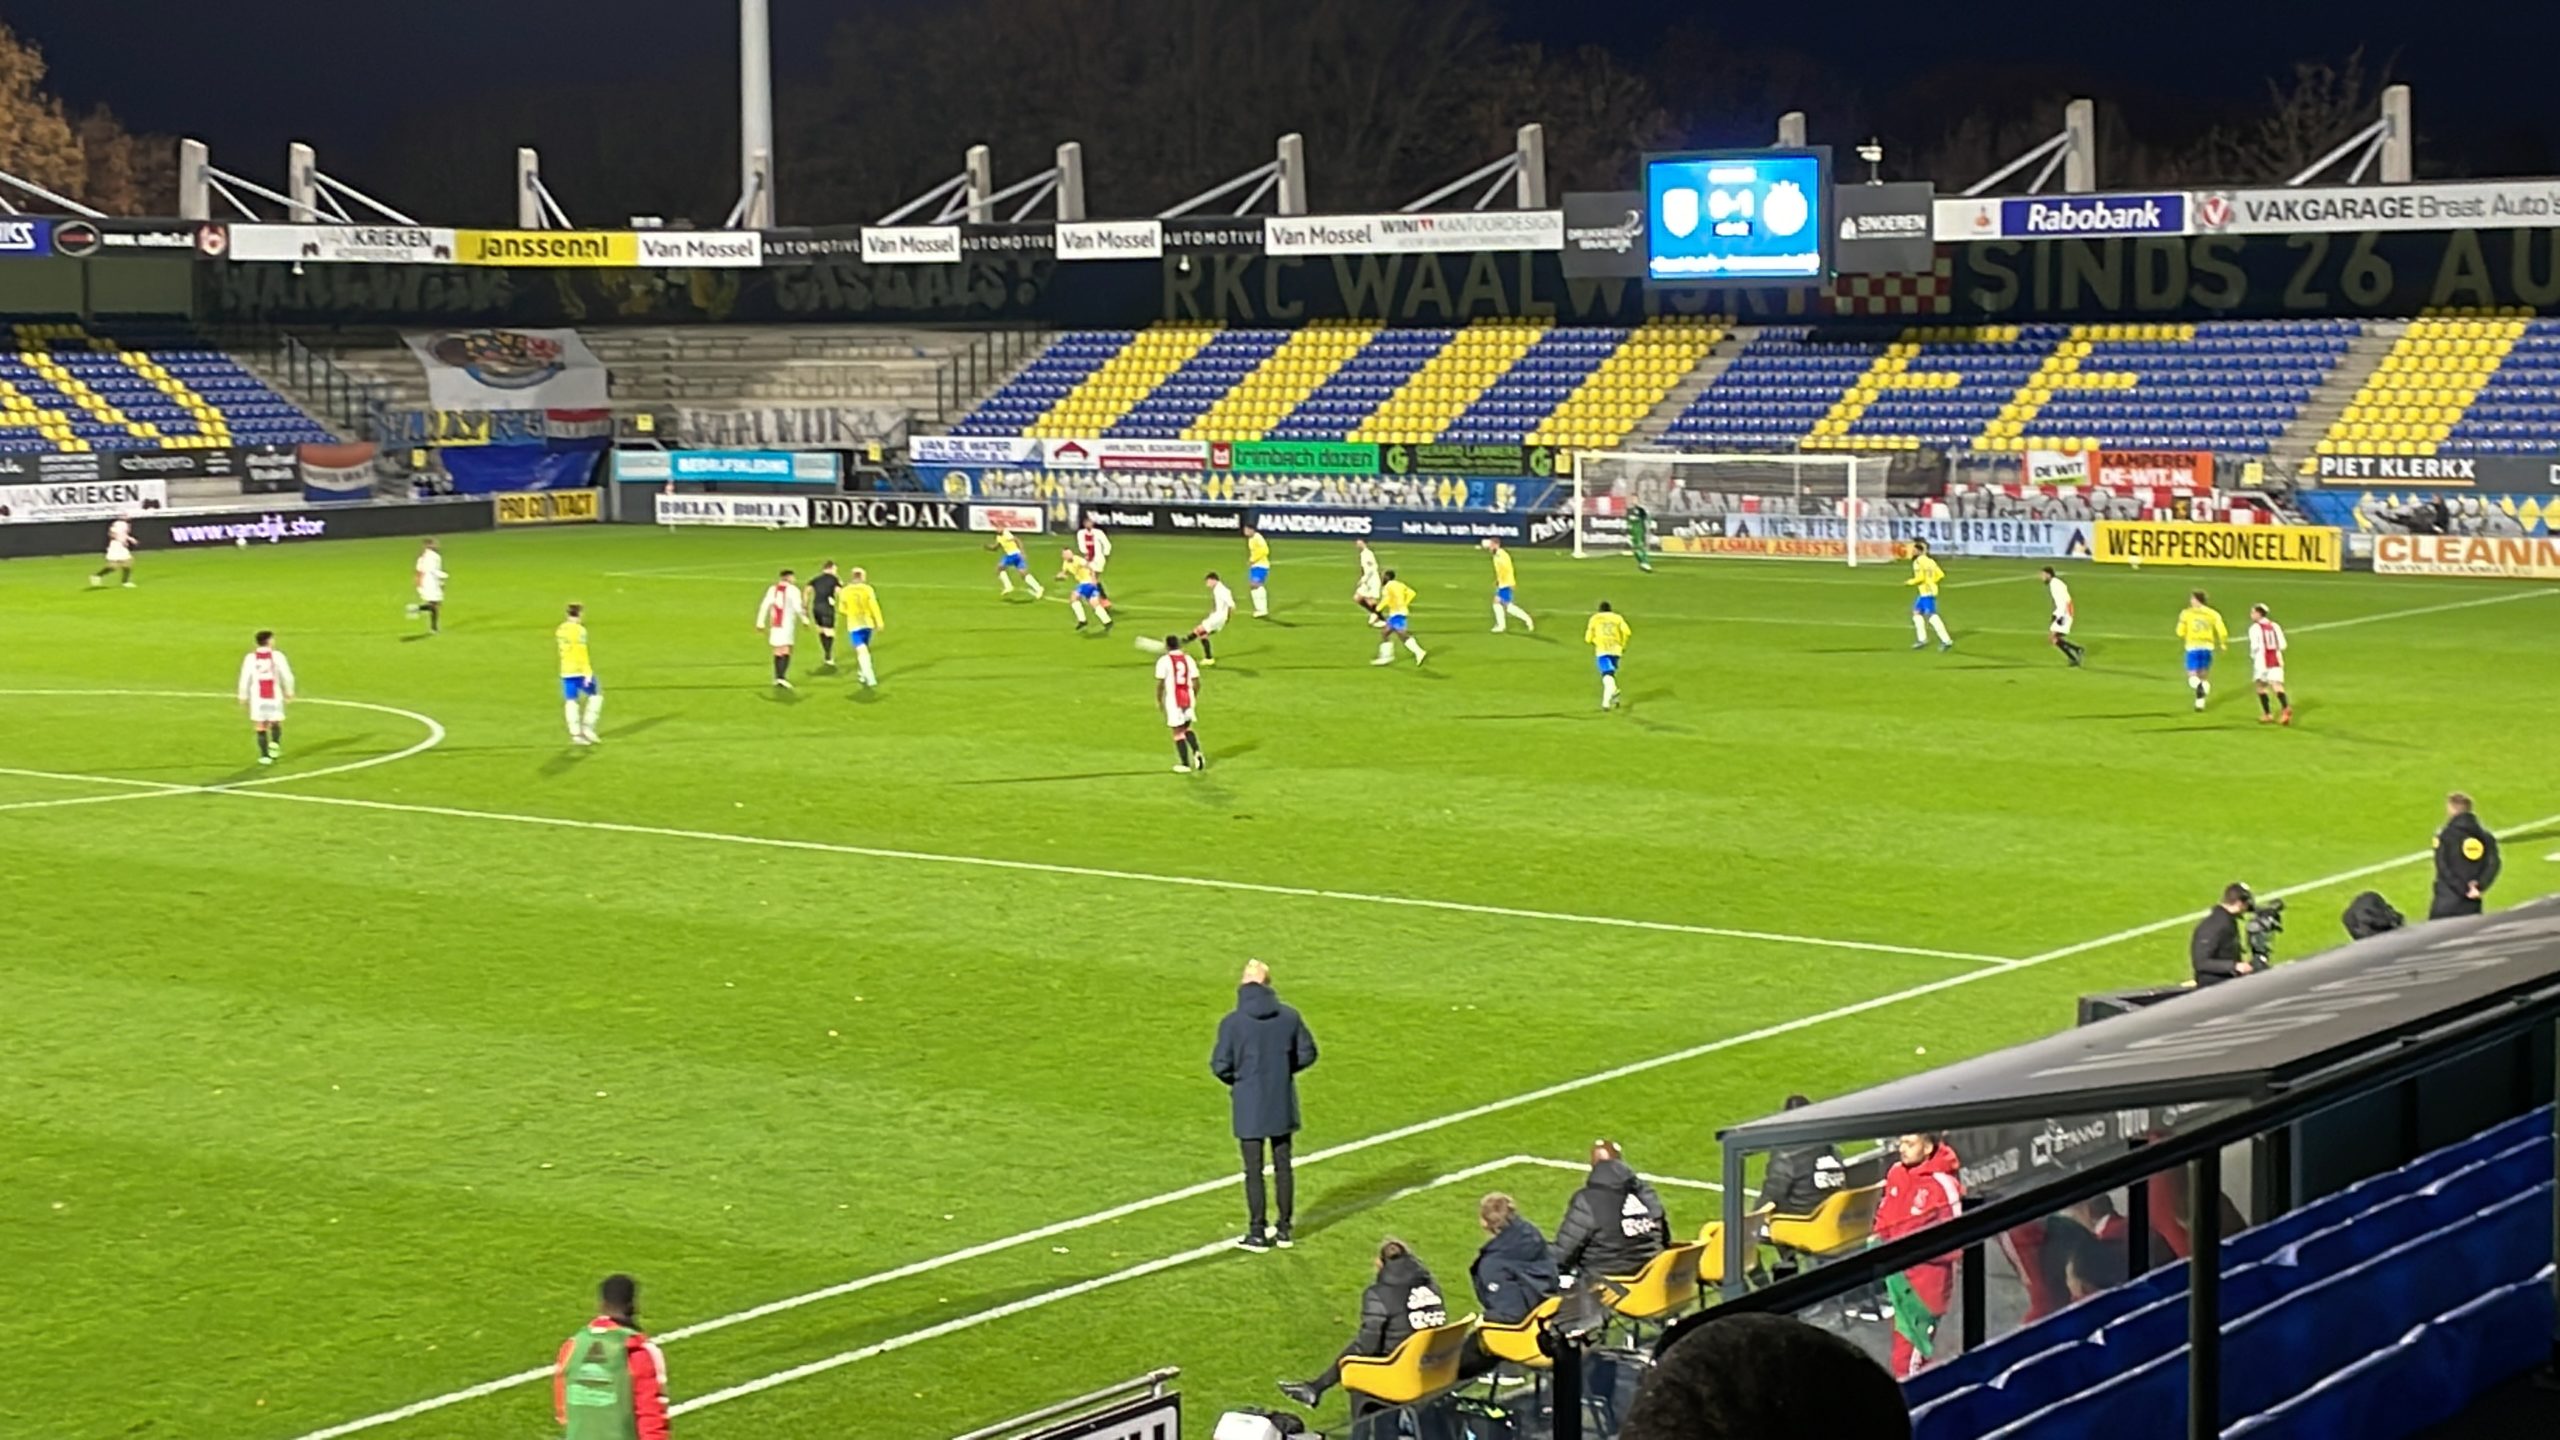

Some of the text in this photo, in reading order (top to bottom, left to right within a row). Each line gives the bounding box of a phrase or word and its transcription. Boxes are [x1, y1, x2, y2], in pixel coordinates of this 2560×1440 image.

[2027, 201, 2161, 231] Rabobank
[2246, 197, 2414, 222] VAKGARAGE
[1858, 215, 1927, 231] SNOEREN
[354, 230, 431, 247] KRIEKEN
[868, 235, 955, 253] Van Mossel
[962, 235, 1054, 250] AUTOMOTIVE
[1062, 230, 1155, 249] Van Mossel
[1164, 231, 1263, 245] AUTOMOTIVE
[1272, 224, 1371, 245] Van Mossel
[643, 239, 755, 258] Van Mossel
[763, 240, 860, 254] AUTOMOTIVE
[1162, 253, 1305, 320] RKC
[1967, 234, 2247, 312] SINDS
[2284, 230, 2393, 309] 26
[2101, 453, 2197, 467] KAMPEREN
[2321, 457, 2476, 479] PIET KLERKX
[50, 484, 139, 505] KRIEKEN
[814, 500, 960, 529] EDEC-DAK
[1171, 512, 1240, 529] Van Mossel
[1257, 514, 1373, 534] MANDEMAKERS
[1761, 517, 2054, 543] INGNIEUSBUREAU BRABANT
[2108, 528, 2326, 563] WERFPERSONEEL.NL
[1175, 660, 1188, 686] 2
